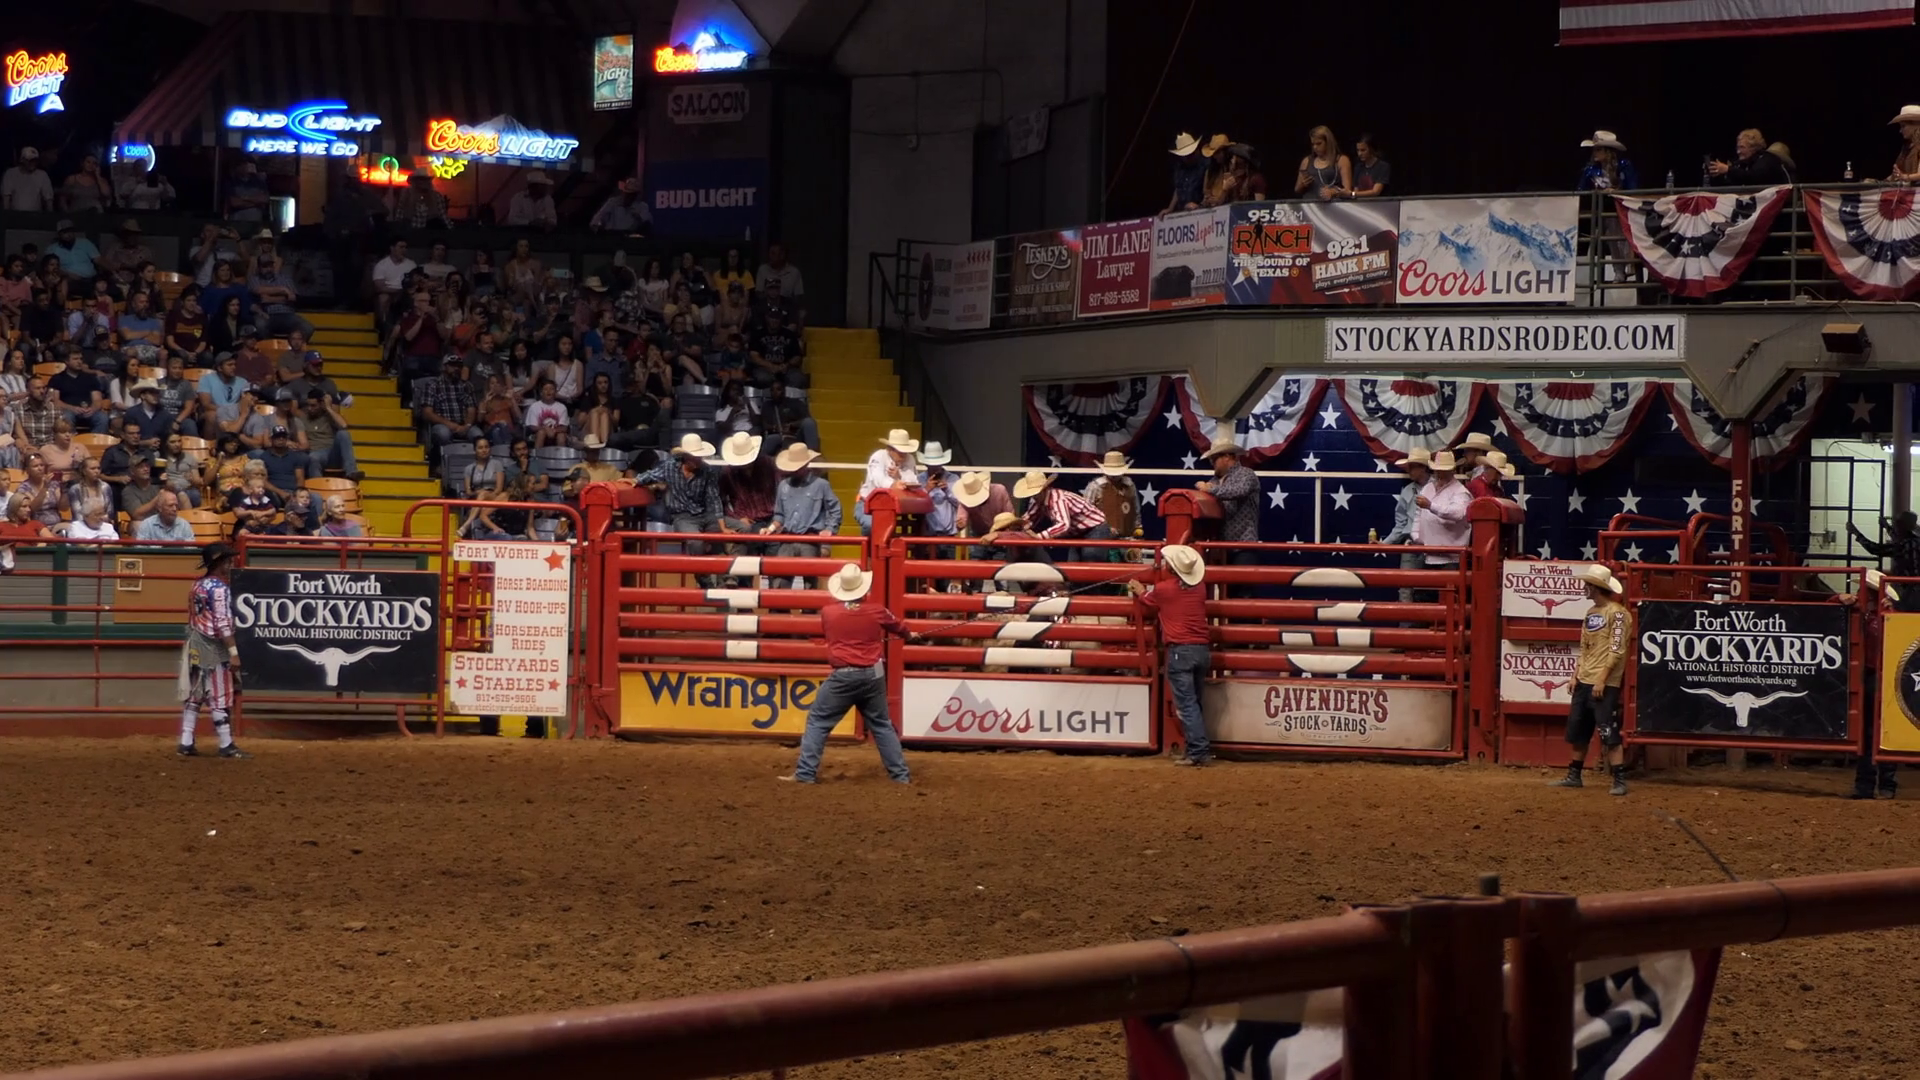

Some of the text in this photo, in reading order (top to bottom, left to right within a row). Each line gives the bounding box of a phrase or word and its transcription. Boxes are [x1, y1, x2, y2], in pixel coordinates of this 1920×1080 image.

[7, 51, 68, 86] Coors
[10, 75, 64, 106] LIGHT
[672, 91, 746, 116] SALOON
[228, 111, 381, 131] BUD LIGHT
[250, 139, 358, 157] HERE WE GO
[429, 120, 578, 159] Coors LIGHT
[656, 187, 757, 208] BUD LIGHT
[1247, 209, 1285, 222] 95.9
[1157, 224, 1195, 247] FLOORS
[1215, 220, 1226, 237] TX
[1083, 234, 1109, 260] JIM
[1111, 228, 1150, 257] LANE
[1327, 236, 1369, 260] 92.1
[1096, 260, 1135, 282] Lawyer
[1233, 257, 1310, 267] THE SOUND OF
[1315, 253, 1386, 279] HANK FM
[1254, 268, 1290, 277] TEXAS
[1315, 270, 1388, 289] plays everything country
[1399, 258, 1571, 297] Coors LIGHT
[1335, 323, 1675, 352] STOCKYARDSRODEO.COM
[1731, 479, 1743, 550] FORT
[458, 545, 538, 560] FORT WORTH
[1529, 564, 1572, 575] Fort Worth
[288, 573, 382, 595] Fort Worth
[497, 577, 568, 592] HORSE BOARDING
[1504, 573, 1586, 590] STOCKYARD
[235, 593, 432, 632] STOCKYARDS
[497, 600, 513, 613] RV
[1694, 609, 1787, 632] Fort Worth
[255, 627, 413, 641] NATIONAL HISTORIC DISTRICT
[512, 638, 546, 651] RIDES
[1527, 644, 1572, 655] Fort Worth
[1641, 631, 1842, 670] STOCKYARDS
[455, 655, 560, 672] STOCKYARDS
[1503, 653, 1576, 671] STOCKYAR
[1668, 661, 1817, 675] NATIONAL HISTORIC DISTRICT
[473, 675, 545, 692] STABLES
[1686, 674, 1797, 686] www.fortworthstockyards.org
[641, 671, 824, 729] Wrangle
[1264, 686, 1389, 723] CAVENDER'S
[930, 696, 1130, 735] Coors LIGHT
[1284, 715, 1367, 735] STOCK YARDS
